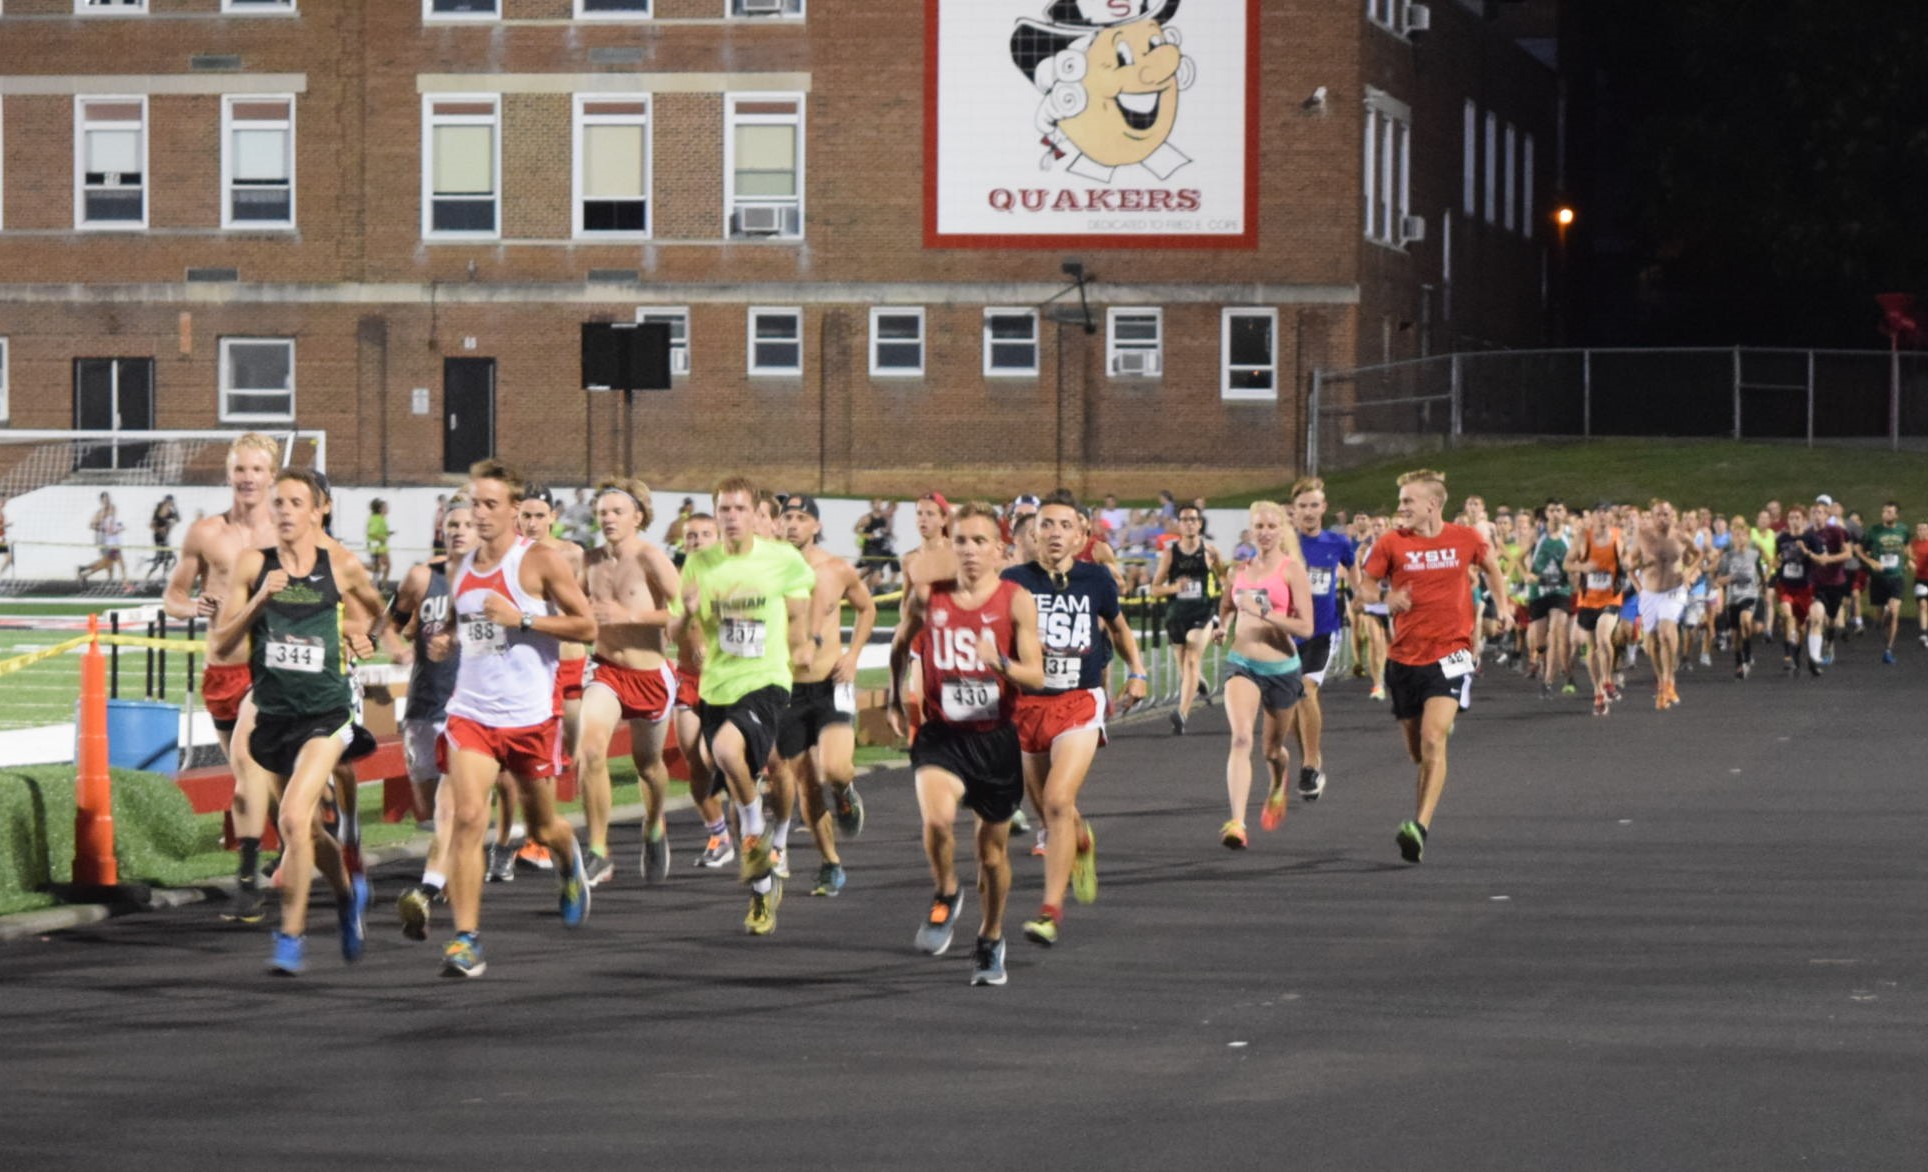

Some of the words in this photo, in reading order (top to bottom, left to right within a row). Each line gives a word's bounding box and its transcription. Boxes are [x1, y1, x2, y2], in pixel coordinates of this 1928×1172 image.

[988, 187, 1202, 214] QUAKERS
[1087, 218, 1147, 230] DEDICATED
[1150, 218, 1164, 230] TO
[1166, 218, 1193, 230] FRED
[1207, 218, 1239, 230] COPE
[1405, 548, 1457, 564] YSU
[1033, 594, 1090, 613] EAM
[276, 645, 312, 665] 344
[1043, 659, 1069, 675] 31
[953, 688, 988, 706] 430
